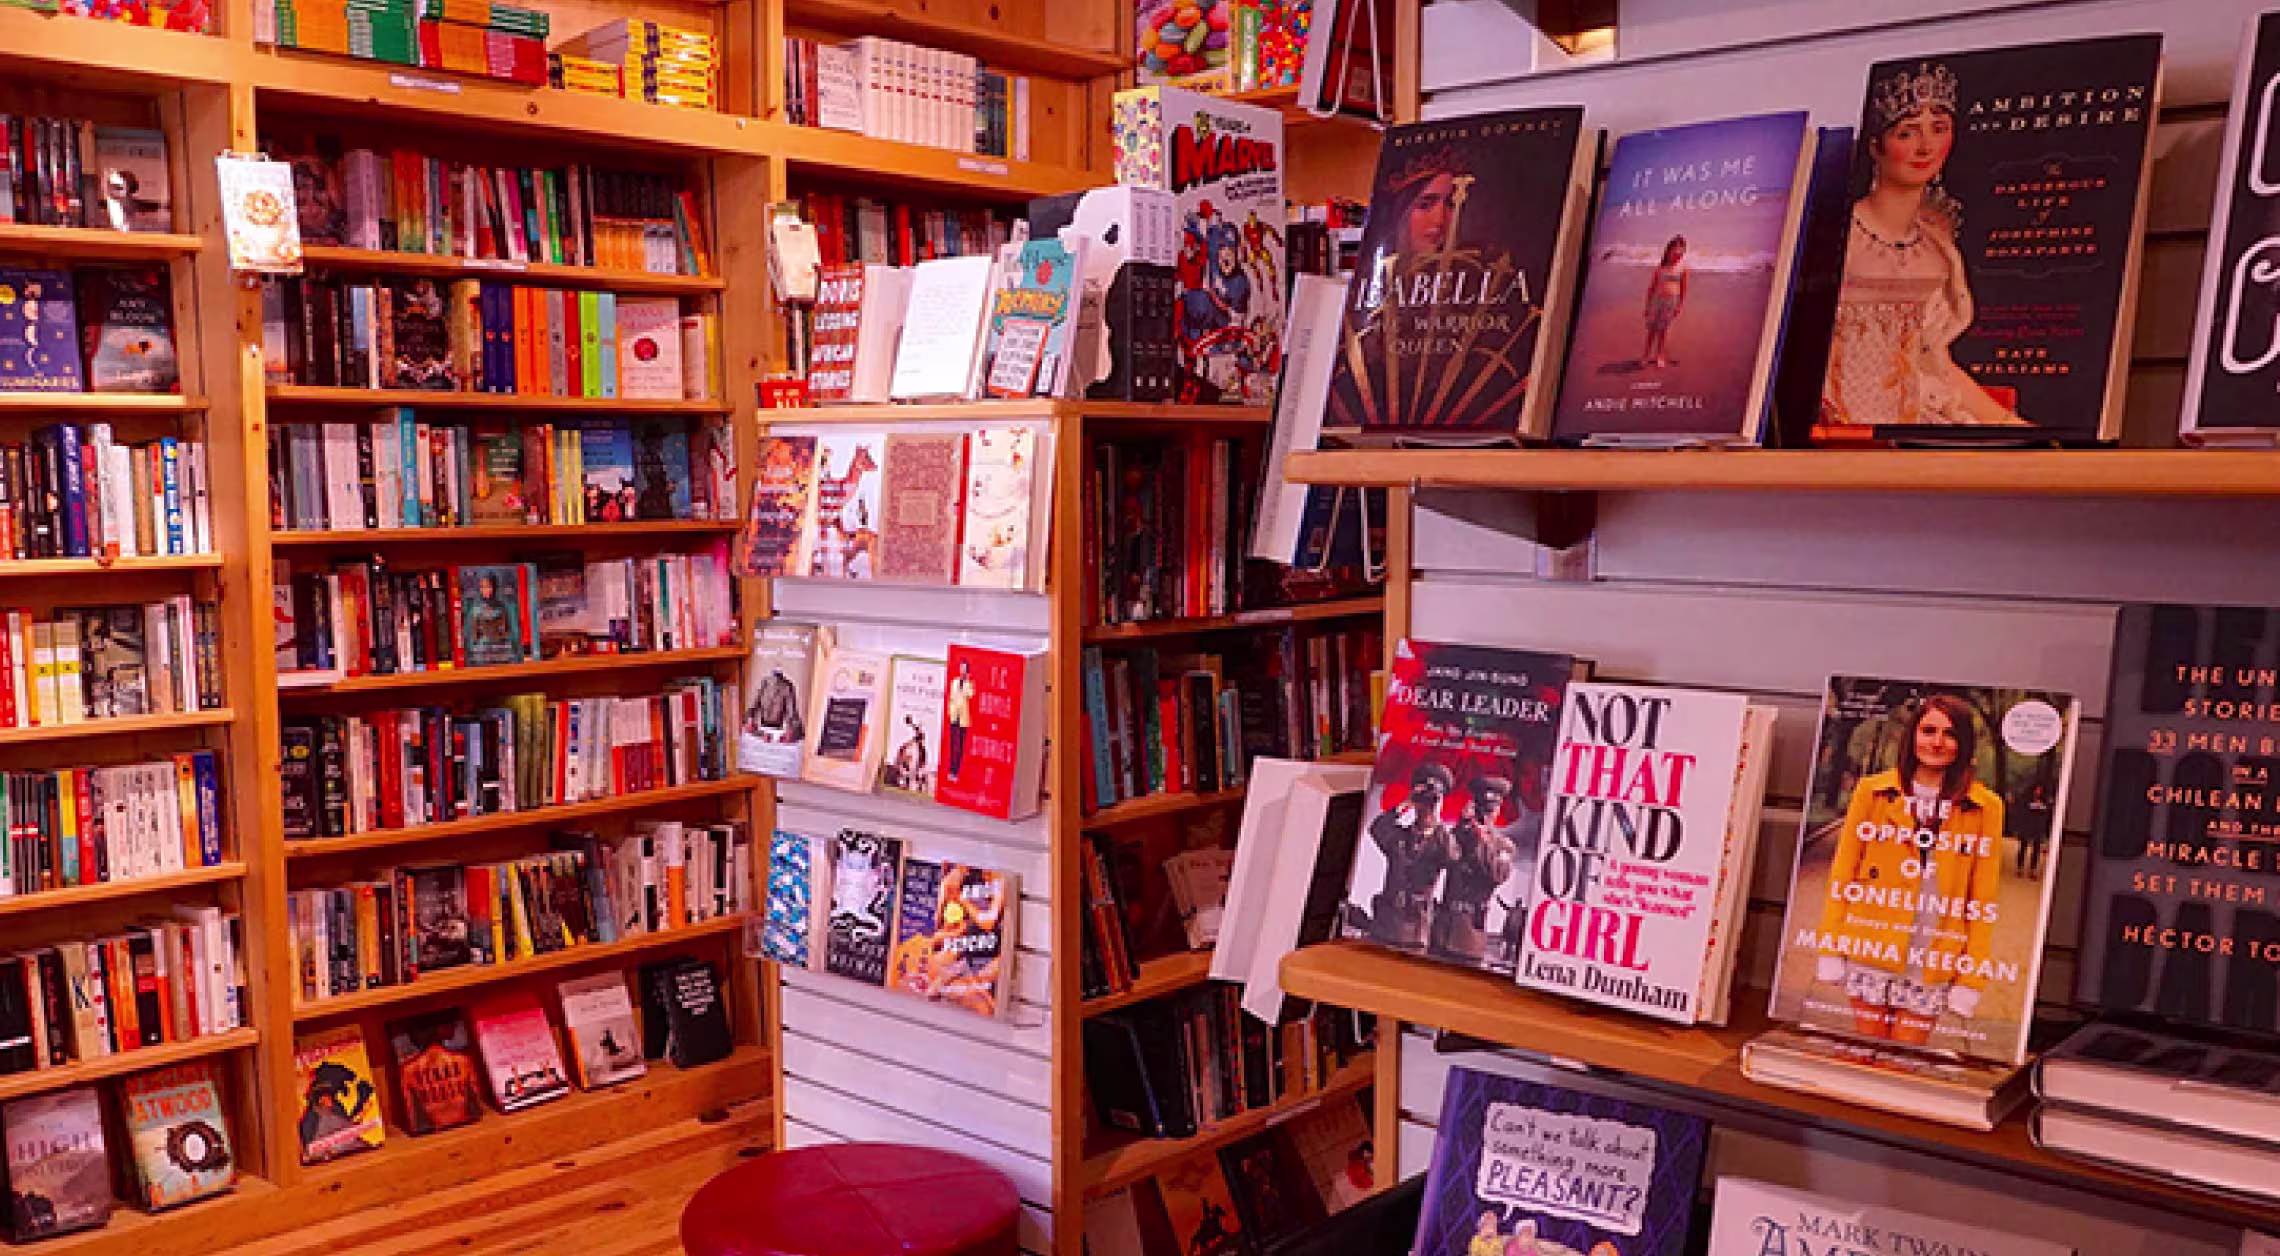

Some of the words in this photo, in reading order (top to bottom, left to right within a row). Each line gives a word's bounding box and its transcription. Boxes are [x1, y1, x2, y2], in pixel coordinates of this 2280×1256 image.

[1969, 84, 2145, 115] AMBITION
[2009, 108, 2140, 131] DESIRE
[1172, 124, 1277, 190] MARVEL
[1632, 168, 1652, 189] IT
[1664, 163, 1710, 185] WAS
[1720, 156, 1757, 177] ME
[1618, 198, 1656, 217] ALL
[1670, 185, 1758, 212] ALONG
[1354, 268, 1530, 310] ISABELLA
[1393, 339, 1463, 355] QUEEN
[1995, 347, 2048, 359] KATE
[1969, 363, 2071, 375] WILLIAMS
[1584, 397, 1627, 411] ANDIE
[1631, 395, 1703, 410] MITCHELL
[2175, 664, 2224, 685] THE
[2236, 667, 2277, 687] UN
[1395, 684, 1454, 710] DEAR
[1459, 692, 1550, 723] LEADER
[2183, 698, 2280, 722] STORIE
[1571, 691, 1671, 750] NOT
[2148, 729, 2177, 750] 33
[2187, 731, 2248, 753] MEN
[2259, 735, 2280, 755] B
[1562, 742, 1697, 807] THAT
[2231, 765, 2250, 778] IN
[2256, 767, 2269, 779] A
[1904, 796, 1952, 819] THE
[2146, 784, 2262, 810] CHILEAN
[1548, 796, 1684, 863] KIND
[1856, 820, 1994, 858] OPPOSITE
[2207, 820, 2243, 834] AND
[1900, 857, 1938, 879] OF
[2146, 840, 2262, 871] MIRACLE
[1540, 847, 1606, 901] OF
[1618, 862, 1661, 882] young
[1662, 869, 1710, 886] woman
[1633, 881, 1659, 896] you
[1661, 884, 1694, 900] what
[2132, 872, 2178, 895] SET
[2189, 877, 2266, 905] THEM
[1831, 878, 2000, 924] LONELINESS
[1529, 899, 1651, 972] GIRL
[2123, 922, 2234, 957] HÉCTOR
[1795, 929, 1901, 963] MARINA
[1906, 946, 2019, 983] KEEGAN
[1523, 953, 1578, 988] Lena
[1582, 961, 1690, 1013] Dunham
[135, 1086, 212, 1122] ATWOOD
[1490, 1109, 1536, 1138] Can't
[1543, 1131, 1561, 1144] we
[1569, 1126, 1599, 1150] talk
[1603, 1135, 1649, 1160] about
[1492, 1140, 1577, 1179] something
[1585, 1162, 1627, 1182] more
[1487, 1159, 1643, 1218] PLEASANT?
[1797, 1212, 1879, 1249] MARK
